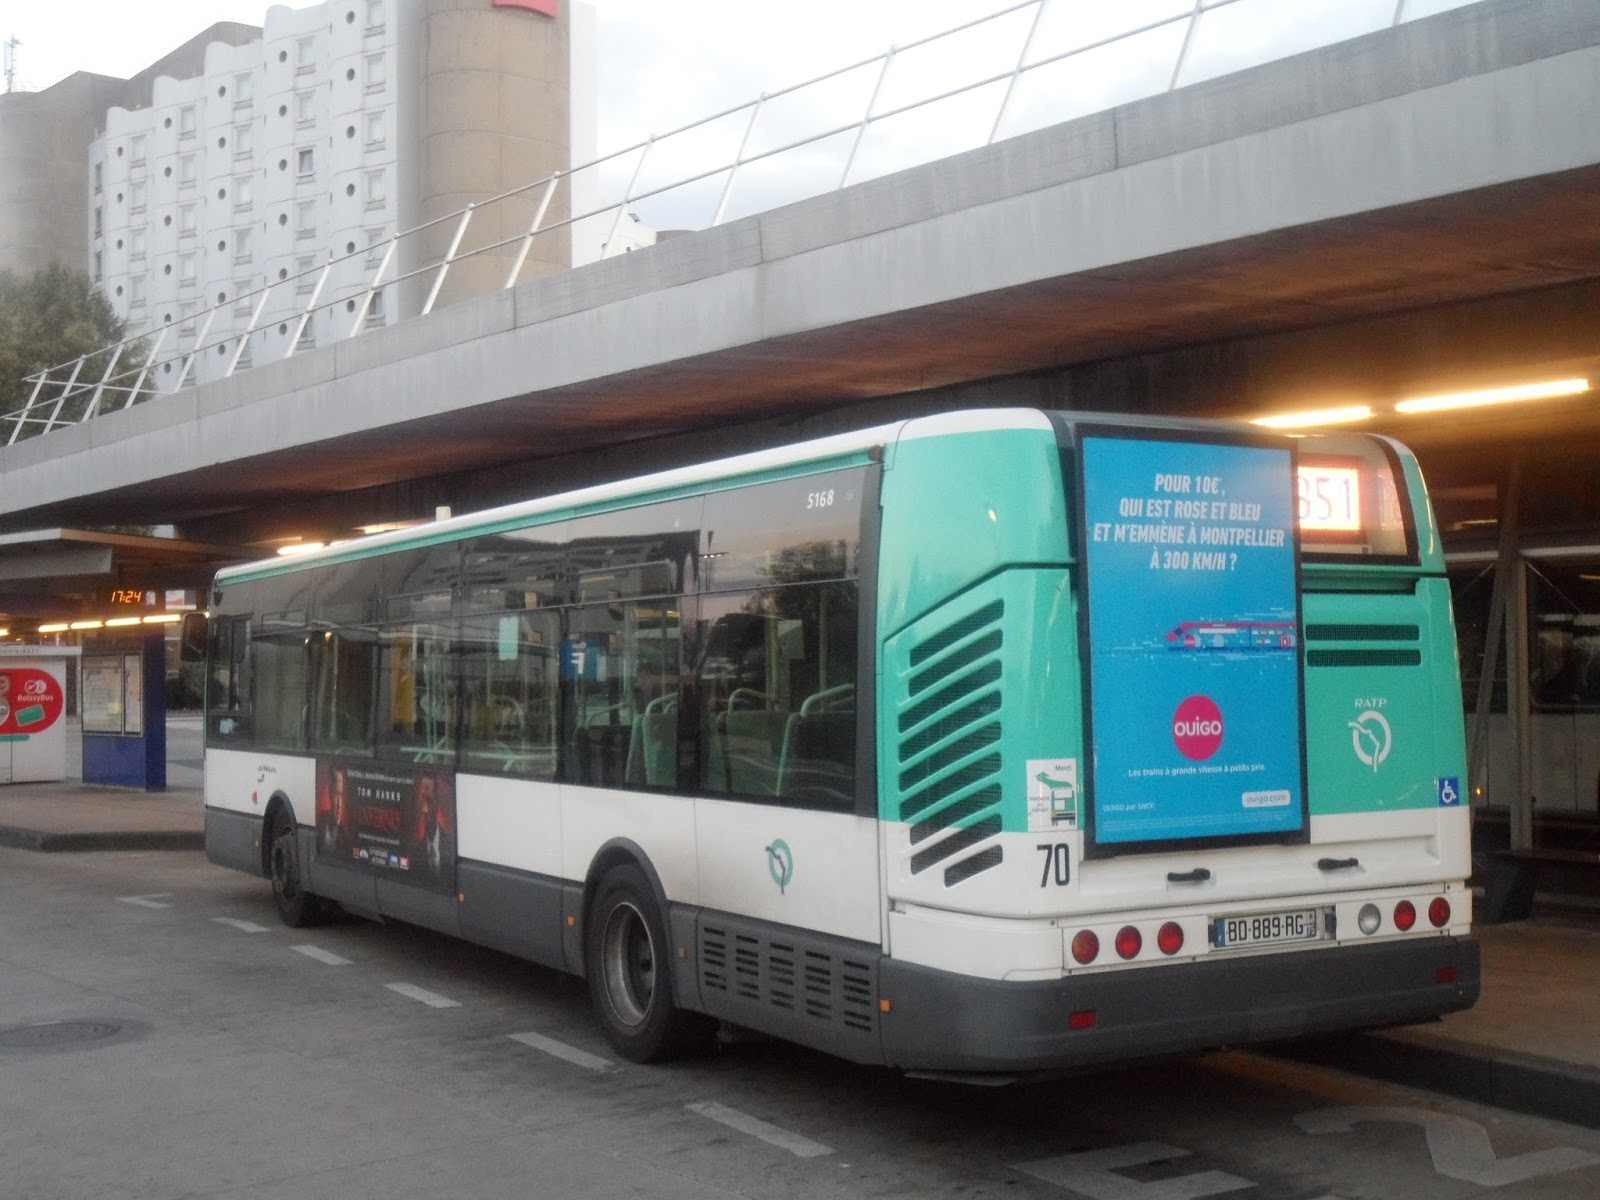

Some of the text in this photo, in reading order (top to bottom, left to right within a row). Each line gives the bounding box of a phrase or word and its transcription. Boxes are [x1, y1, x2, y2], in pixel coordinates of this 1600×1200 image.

[1154, 473, 1191, 493] POUR
[806, 489, 834, 509] 5168
[1119, 497, 1261, 521] QUI EST ROSE ET BLEU
[1093, 520, 1285, 547] ET M'EMMÈNE À MONTPELLIER
[1149, 545, 1238, 571] À 300 KM/H ?
[111, 590, 142, 603] 17:24
[1354, 698, 1388, 708] RATP
[1128, 763, 1267, 777] Les trains à grande vitesse à petits prix.
[358, 786, 401, 802] TOM HANKS
[1246, 793, 1286, 805] ouigo.com
[1103, 803, 1125, 812] OUIGO
[1126, 804, 1137, 812] par
[1036, 842, 1071, 888] 70
